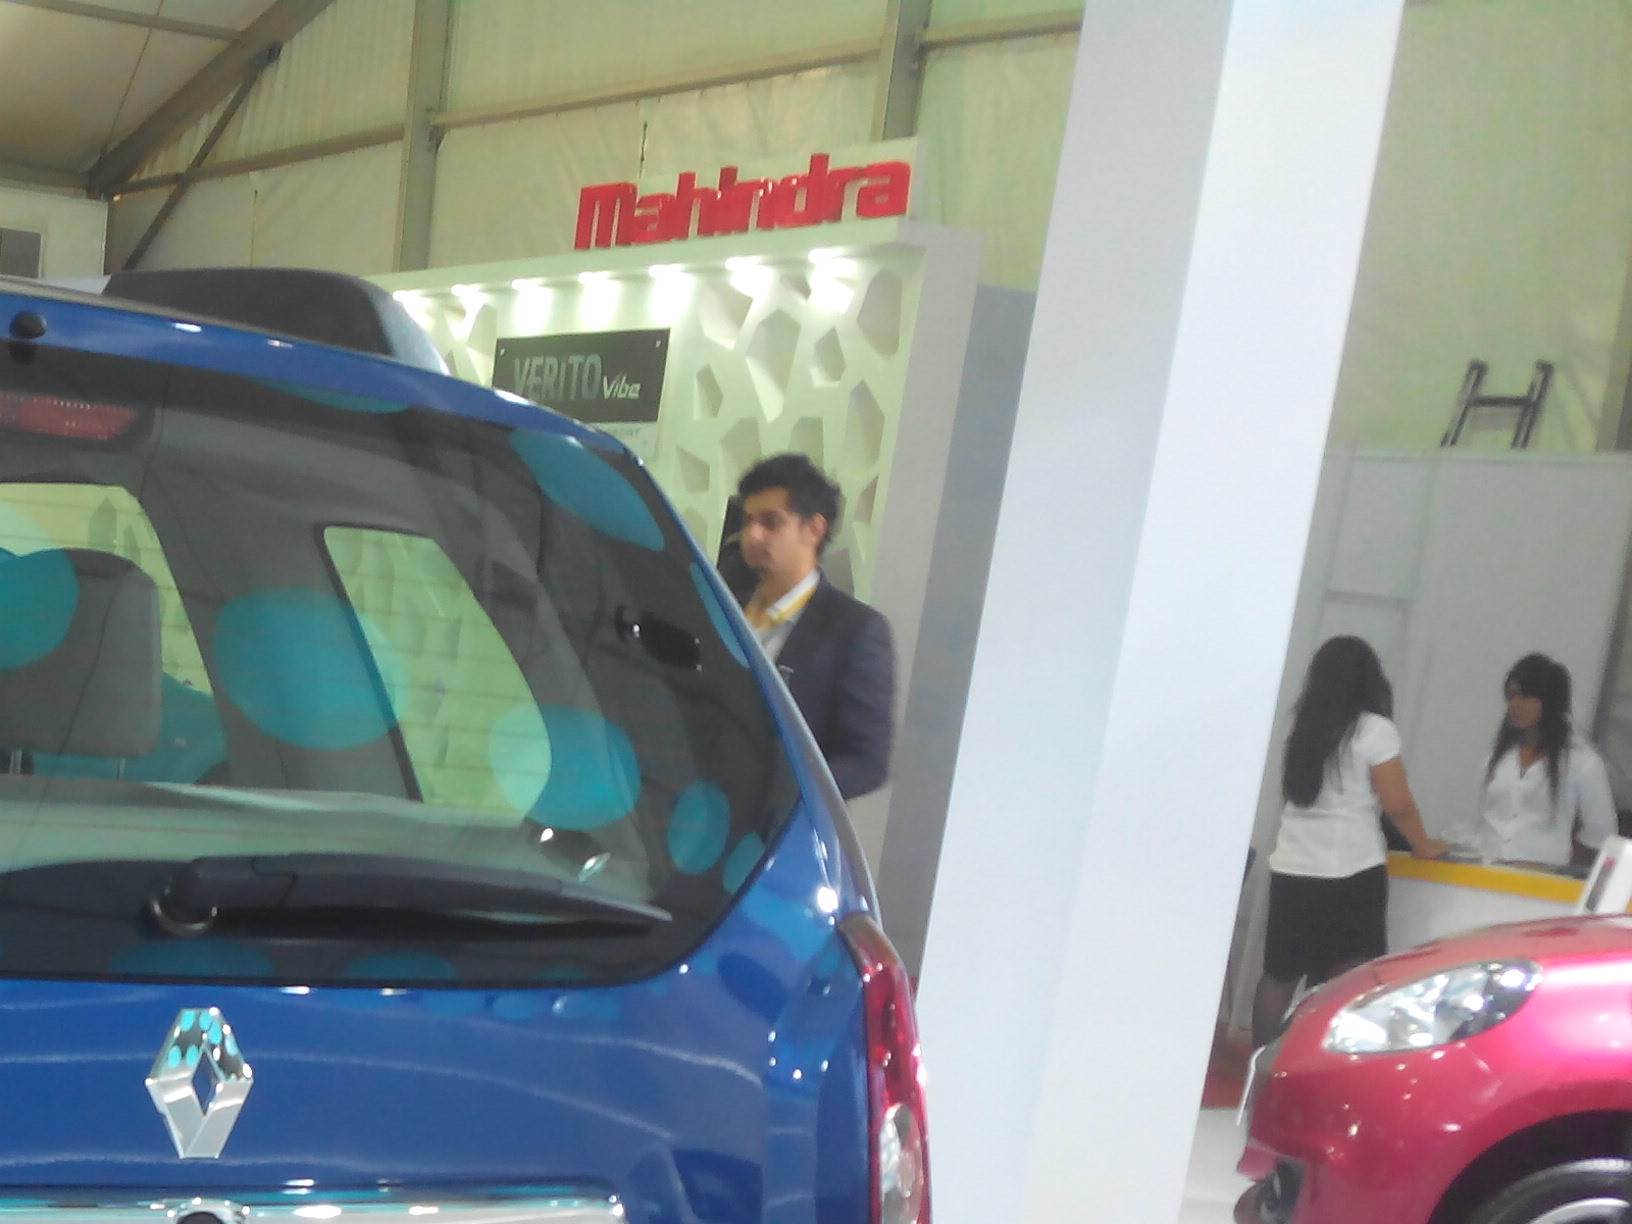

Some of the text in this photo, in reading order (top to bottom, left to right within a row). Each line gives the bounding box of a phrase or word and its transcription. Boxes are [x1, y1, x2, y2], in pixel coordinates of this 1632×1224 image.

[573, 152, 912, 250] Mahindra
[514, 353, 642, 401] VERITO Vibe
